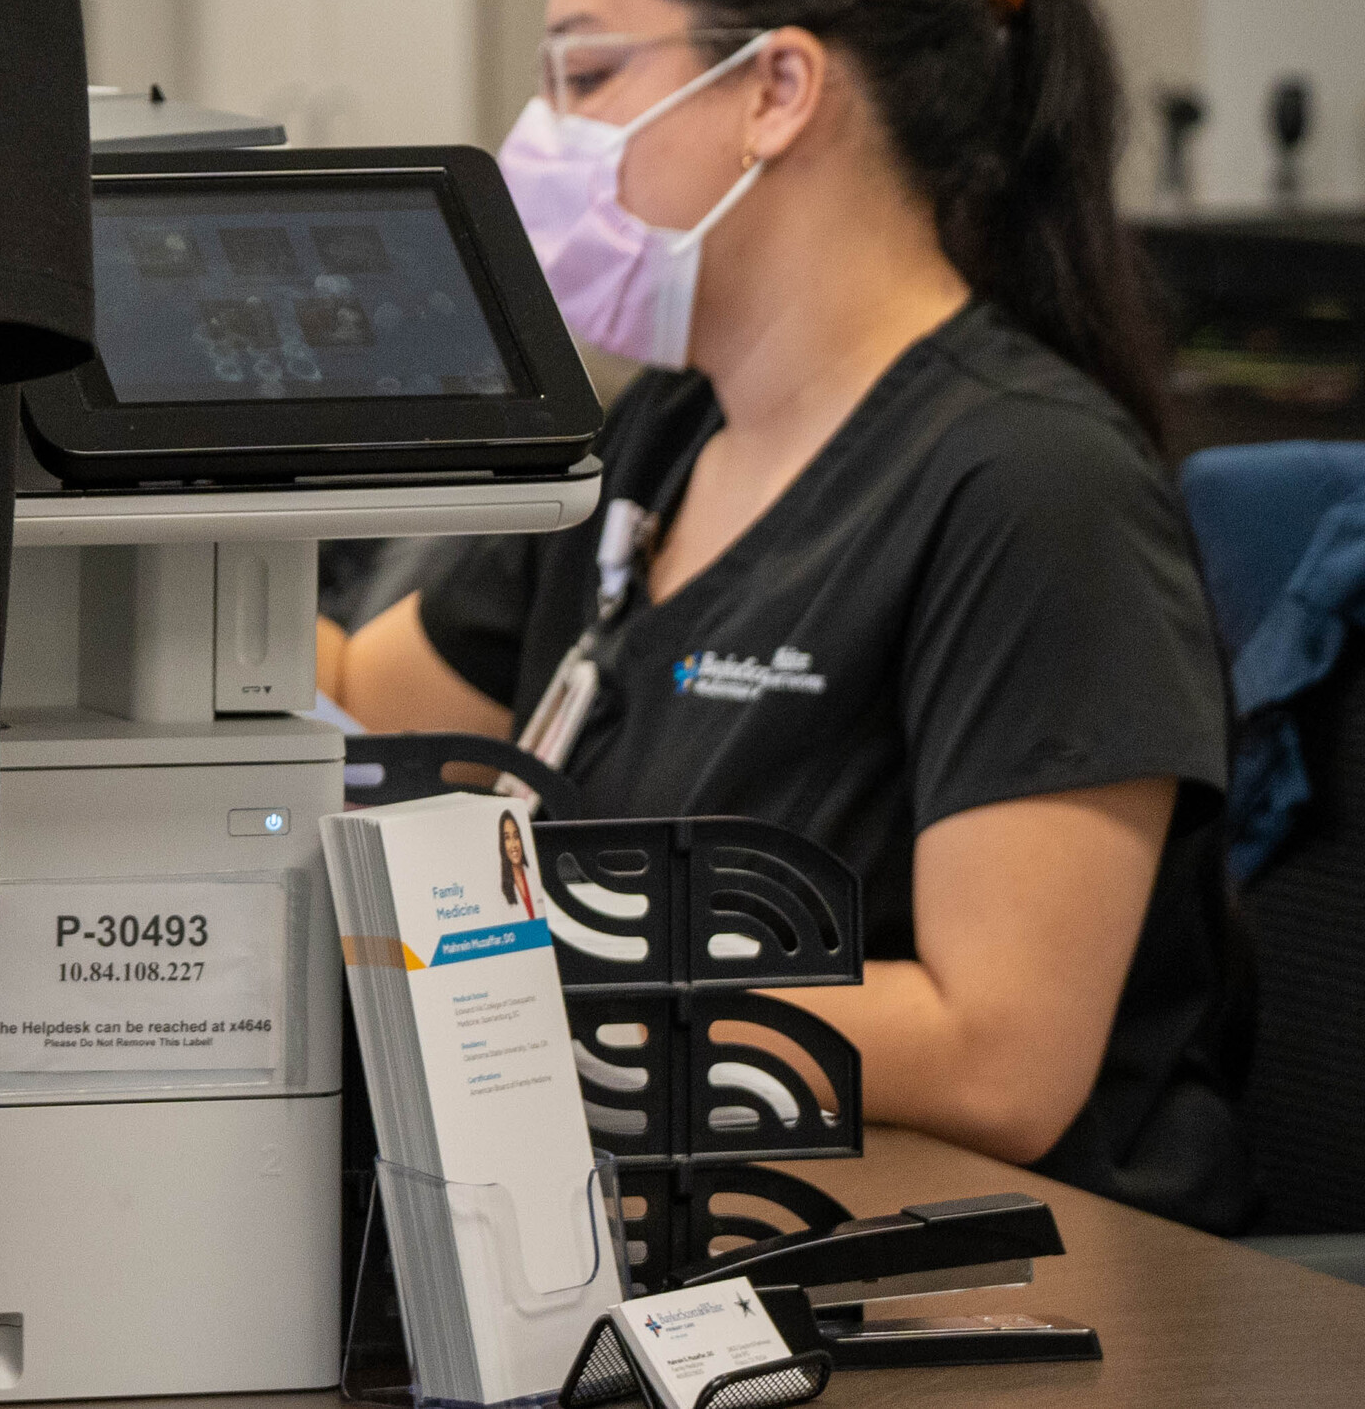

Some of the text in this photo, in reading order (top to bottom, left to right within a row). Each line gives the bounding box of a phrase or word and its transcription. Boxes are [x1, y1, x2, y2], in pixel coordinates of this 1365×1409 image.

[432, 883, 464, 899] Family
[436, 903, 480, 921] Medicine
[55, 914, 208, 948] P-30493
[58, 961, 205, 982] 10.84.108.227
[22, 1021, 90, 1035] Helpdesk
[95, 1022, 121, 1033] can
[126, 1020, 144, 1033] be
[148, 1020, 207, 1033] reached
[212, 1020, 226, 1032] at
[230, 1019, 272, 1033] x4646
[44, 1038, 77, 1047] Please
[80, 1038, 93, 1047] Do
[96, 1038, 113, 1047] Not
[116, 1038, 156, 1047] Remove
[159, 1038, 180, 1046] This
